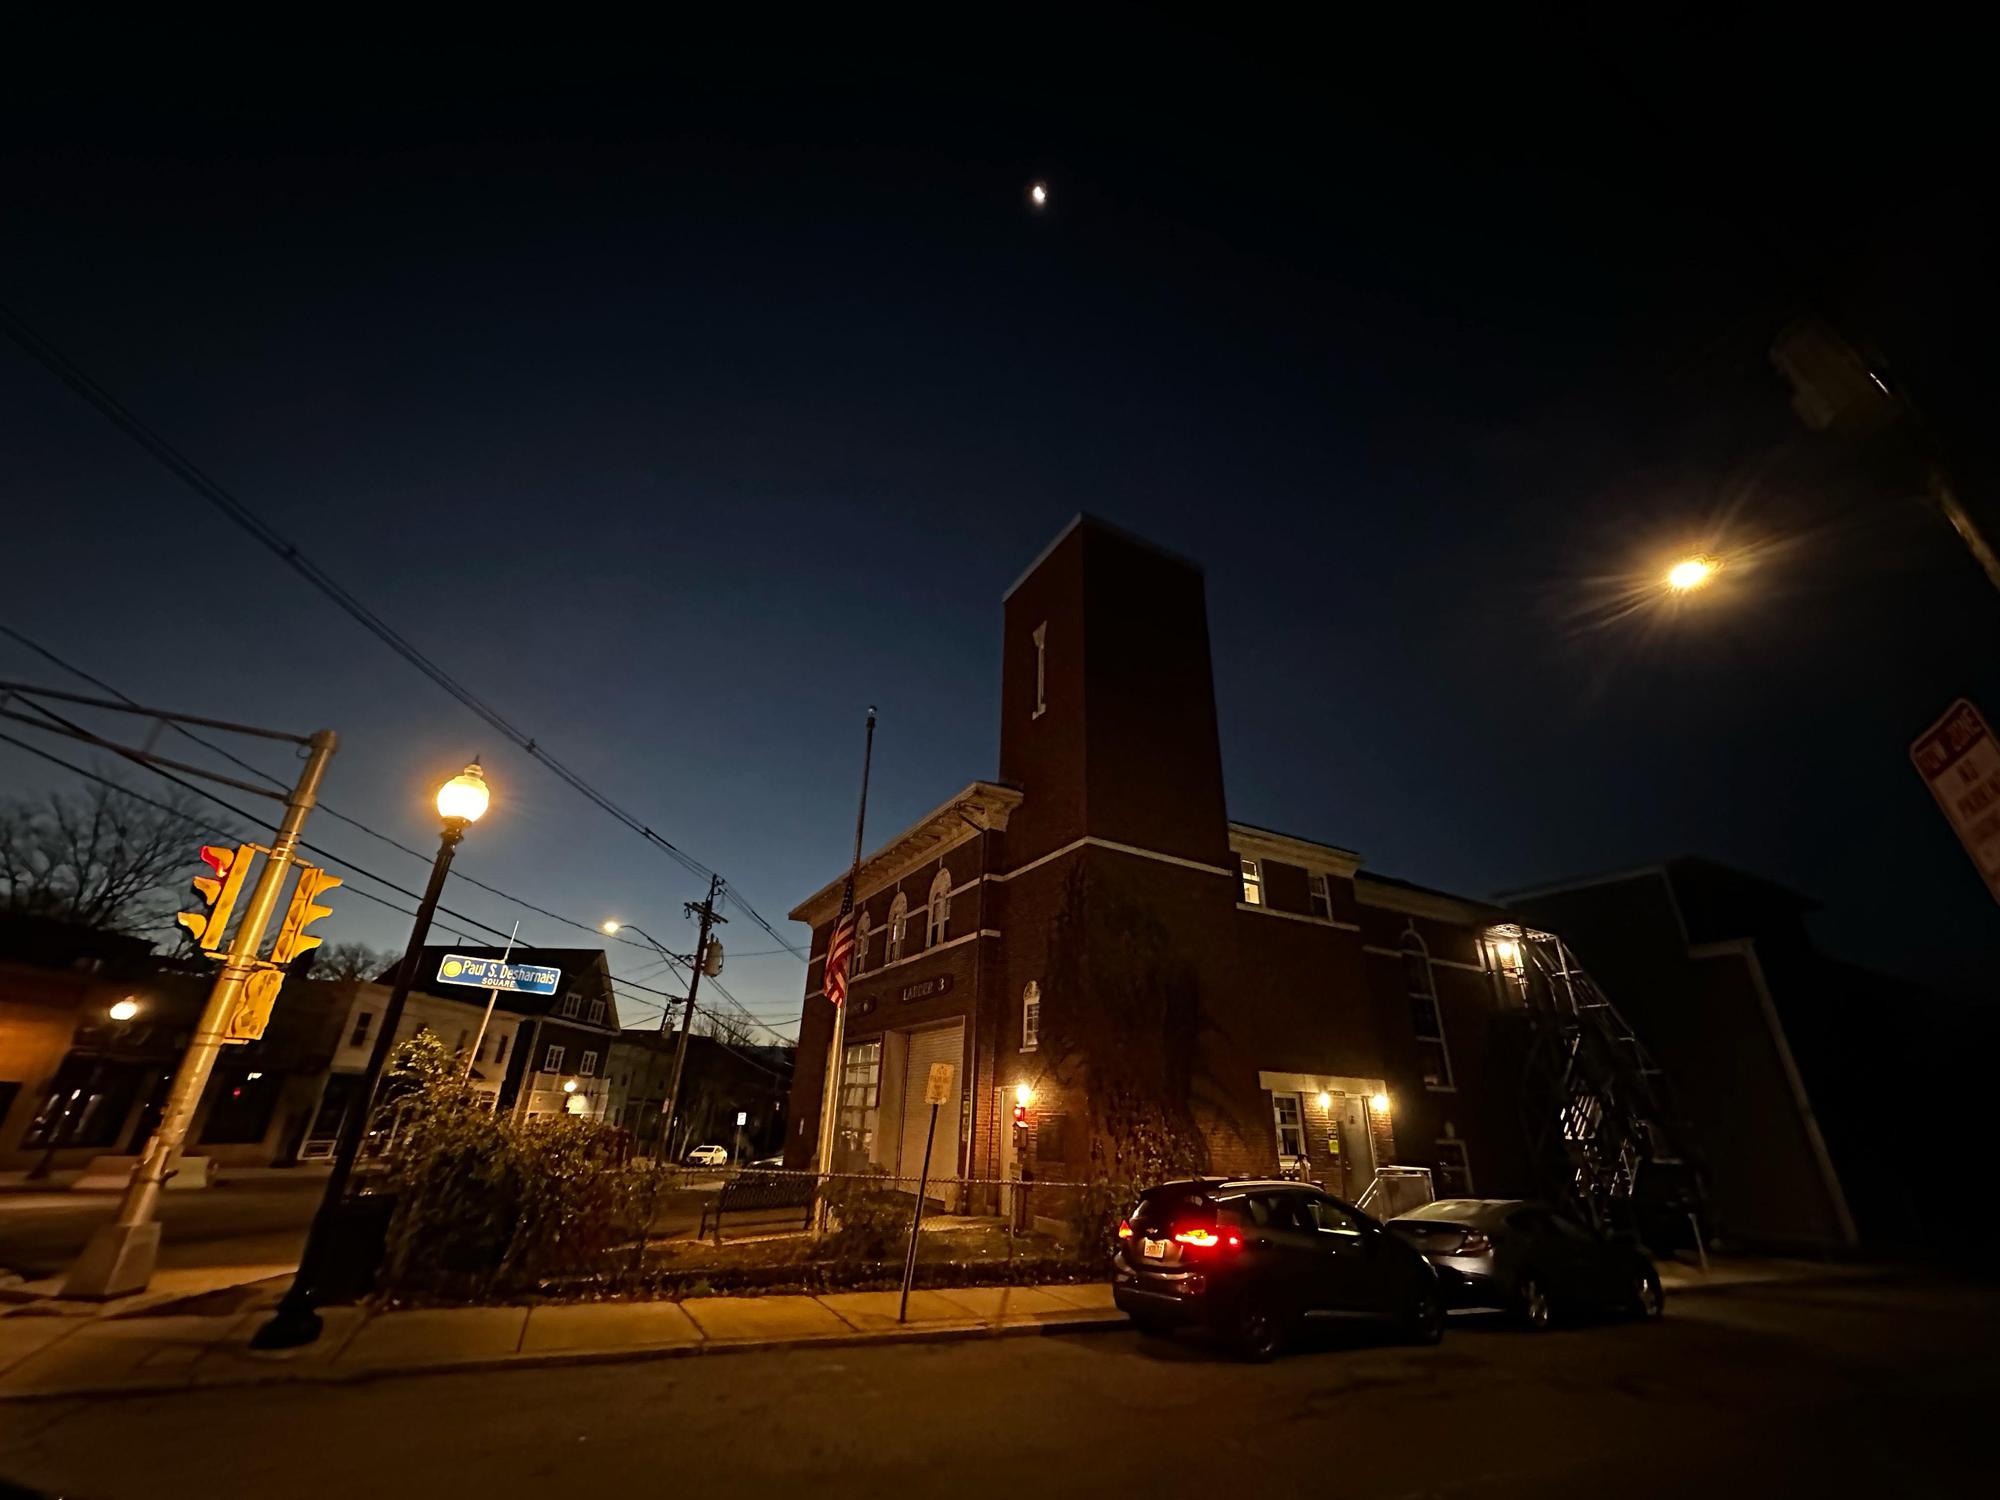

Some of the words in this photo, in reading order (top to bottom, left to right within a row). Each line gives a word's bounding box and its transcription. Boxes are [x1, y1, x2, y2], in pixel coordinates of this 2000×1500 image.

[461, 960, 486, 976] Paul
[488, 963, 498, 978] S.
[500, 964, 556, 985] Desharnais
[481, 977, 517, 988] SQUARE
[937, 977, 945, 992] 3
